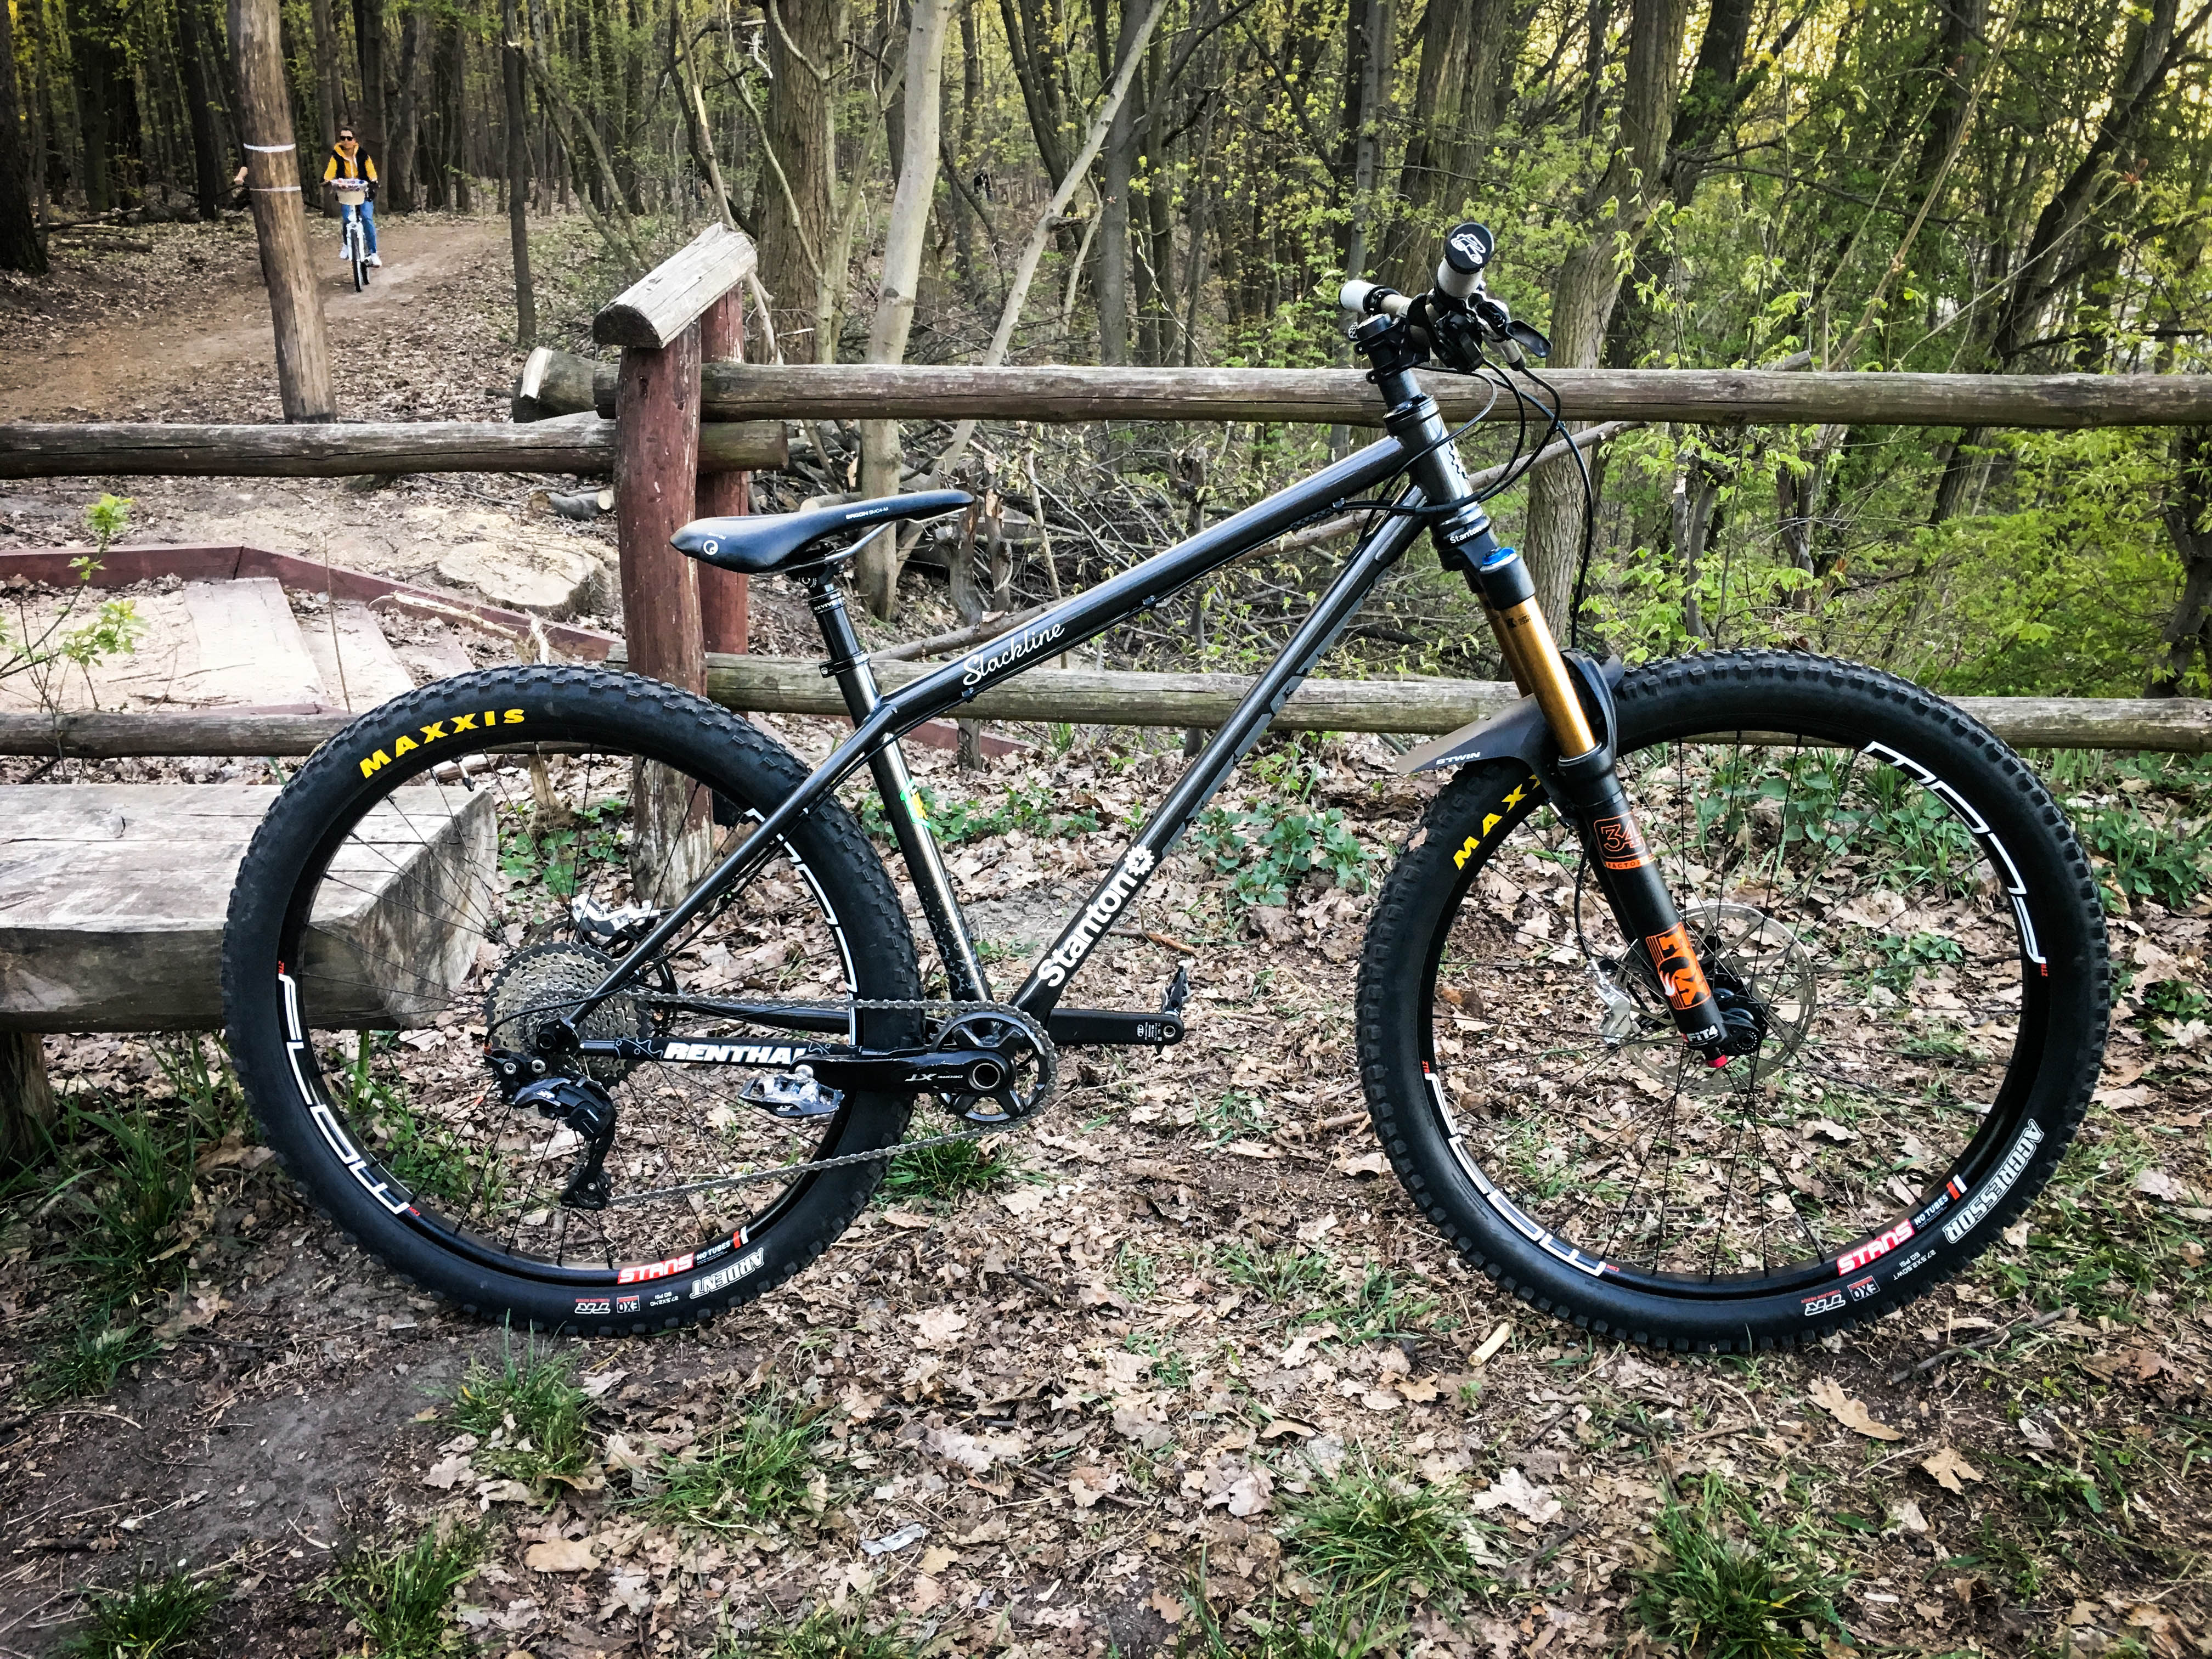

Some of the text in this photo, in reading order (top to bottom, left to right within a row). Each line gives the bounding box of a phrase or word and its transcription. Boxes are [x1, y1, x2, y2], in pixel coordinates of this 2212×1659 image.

[845, 511, 868, 520] ERGON
[1449, 525, 1482, 543] Stanton
[963, 623, 1065, 686] Slackline
[359, 709, 525, 779] MAXXIS
[1453, 774, 1541, 870] MAX
[1600, 820, 1643, 852] 34
[1037, 871, 1138, 987] Stanton
[1657, 922, 1711, 1006] FOX
[905, 1073, 937, 1081] XT
[1942, 1119, 2045, 1244] AGGRESSOR
[1838, 1220, 1914, 1274] STANS
[1914, 1213, 1926, 1226] NO
[1925, 1194, 1949, 1216] TUBES
[619, 1253, 693, 1283] STANS
[697, 1251, 707, 1261] NO
[707, 1240, 731, 1256] TUBES
[689, 1248, 764, 1299] ARDENT
[1893, 1249, 1937, 1280] 27.5X2.50WT
[1899, 1251, 1921, 1268] 60 PSI
[618, 1301, 640, 1313] EXO
[1804, 1294, 1846, 1316] TR
[1851, 1282, 1877, 1301] EXO
[574, 1302, 611, 1314] TR
